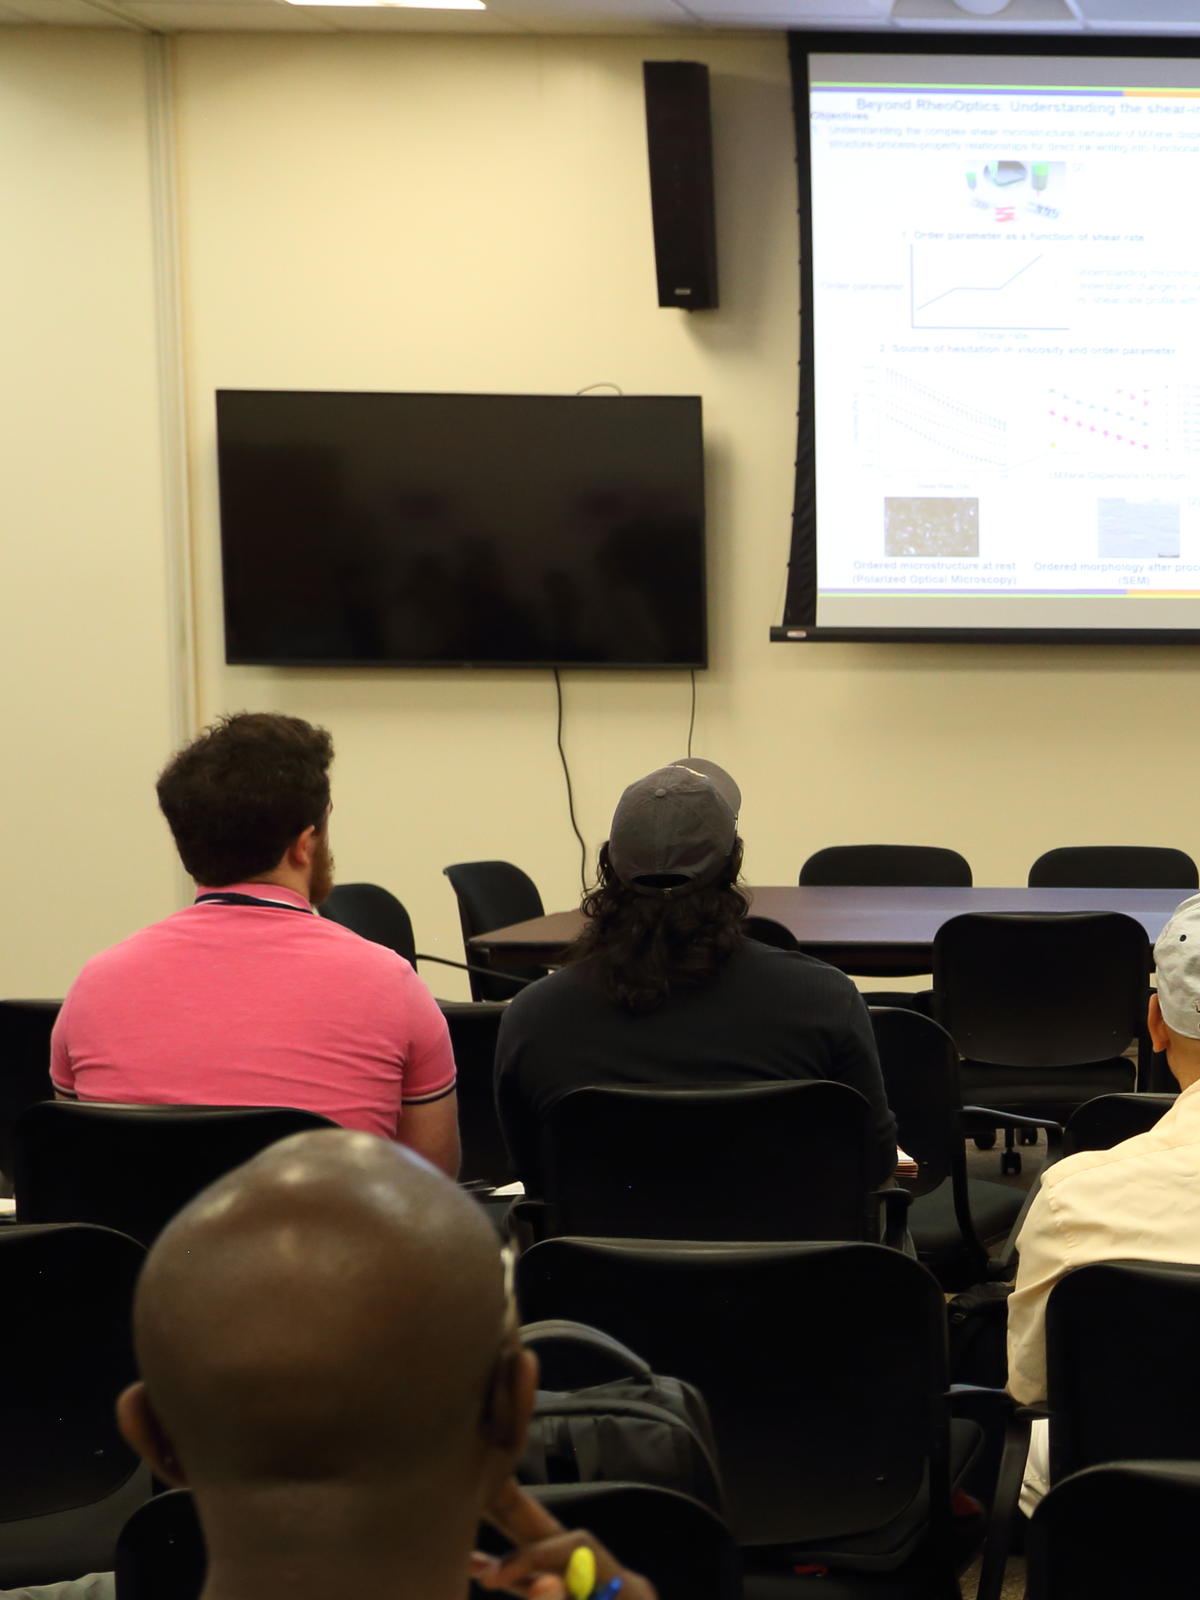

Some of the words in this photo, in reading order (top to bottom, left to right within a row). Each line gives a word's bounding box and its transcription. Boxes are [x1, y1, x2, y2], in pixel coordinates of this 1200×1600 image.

[856, 98, 912, 114] Beyond
[916, 98, 1003, 114] RheoOptics:
[1010, 100, 1115, 116] Understanding
[1120, 102, 1142, 114] the
[913, 231, 945, 241] Order
[947, 232, 1002, 243] parameter
[1029, 231, 1073, 243] function
[1077, 232, 1089, 242] of
[1092, 233, 1121, 243] shear
[1123, 233, 1145, 243] rate
[891, 343, 930, 353] Source
[1068, 346, 1088, 356] and
[1090, 346, 1120, 357] order
[1122, 347, 1176, 358] parameter
[853, 560, 897, 572] Ordered
[900, 561, 980, 573] microstructure
[982, 562, 993, 573] at
[995, 562, 1017, 573] rest
[1033, 561, 1078, 573] Ordered
[1080, 561, 1145, 575] morphology
[1148, 562, 1173, 573] after
[851, 574, 907, 586] (Polarized
[909, 574, 948, 586] Optical
[950, 574, 1017, 587] Microscopy)
[1117, 575, 1151, 588] (SEM)
